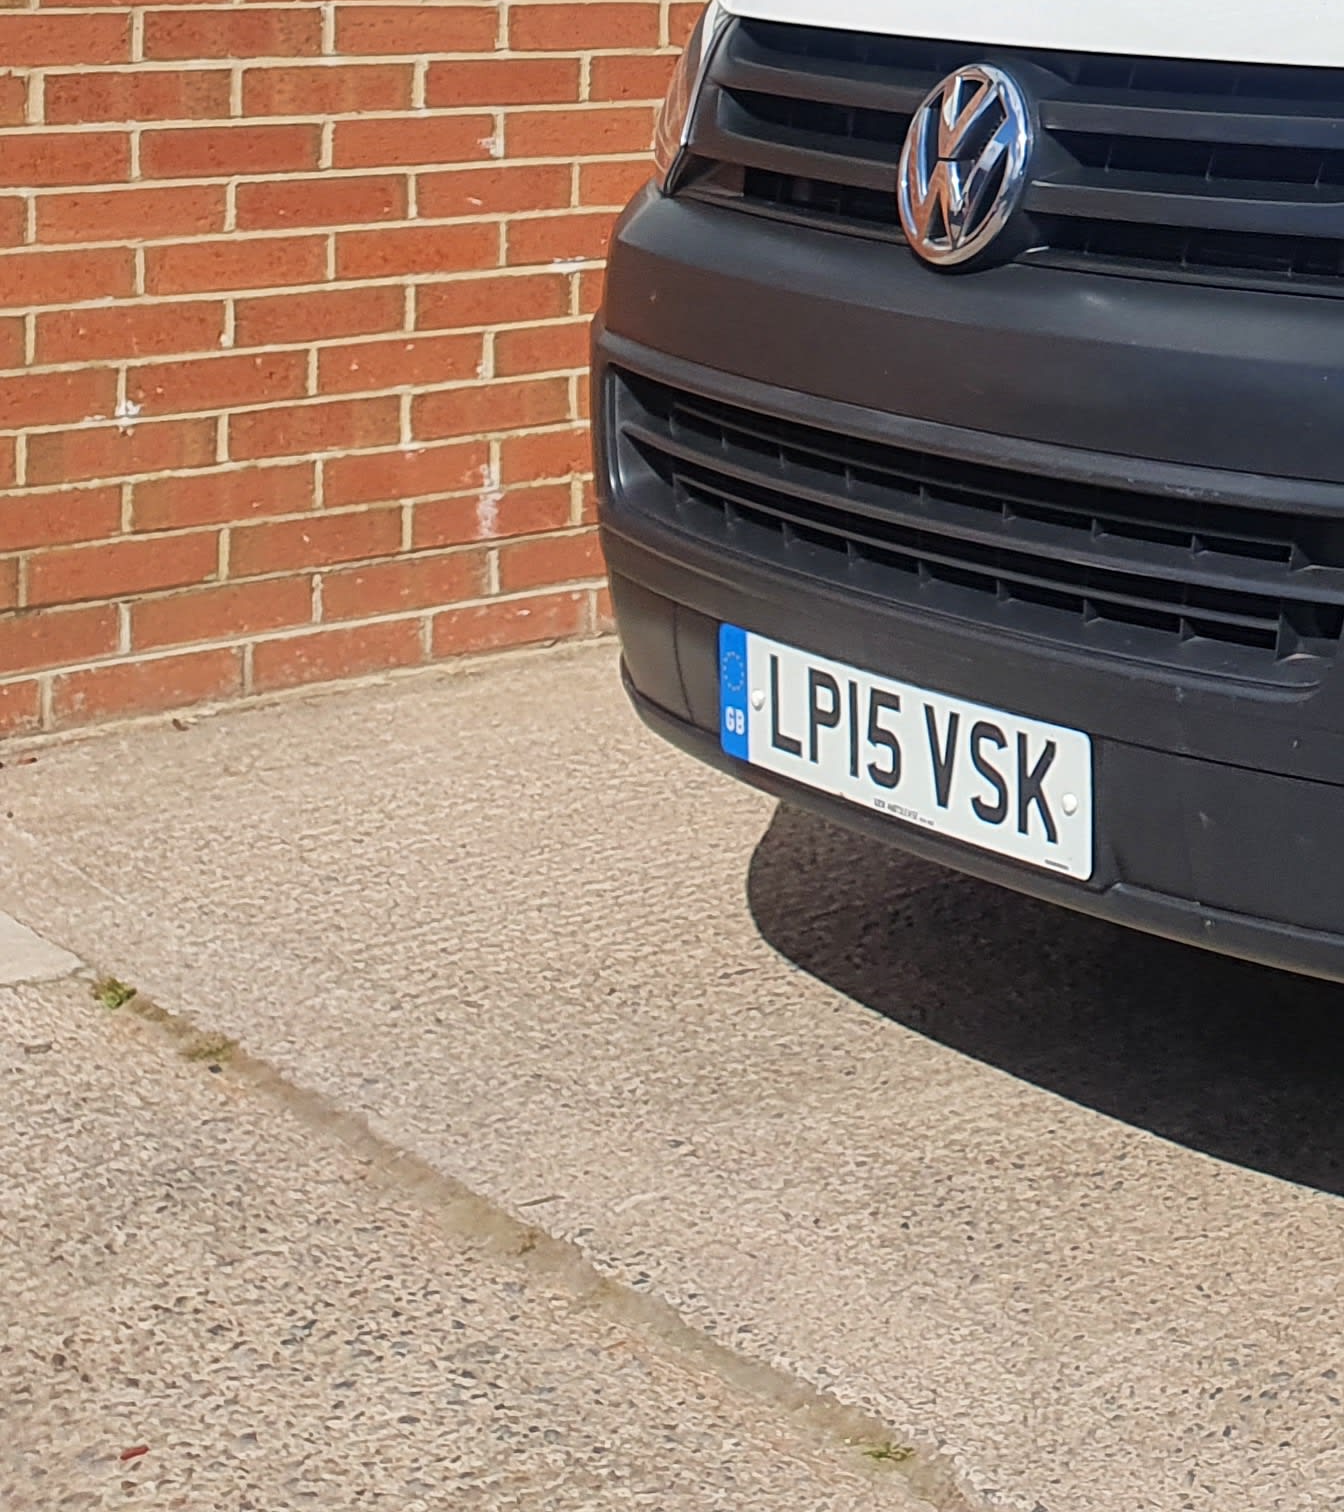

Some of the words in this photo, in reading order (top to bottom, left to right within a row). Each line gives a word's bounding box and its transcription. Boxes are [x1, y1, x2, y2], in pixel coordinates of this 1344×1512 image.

[725, 706, 746, 736] GB
[769, 653, 902, 790] LP15
[923, 703, 1059, 845] VSK
